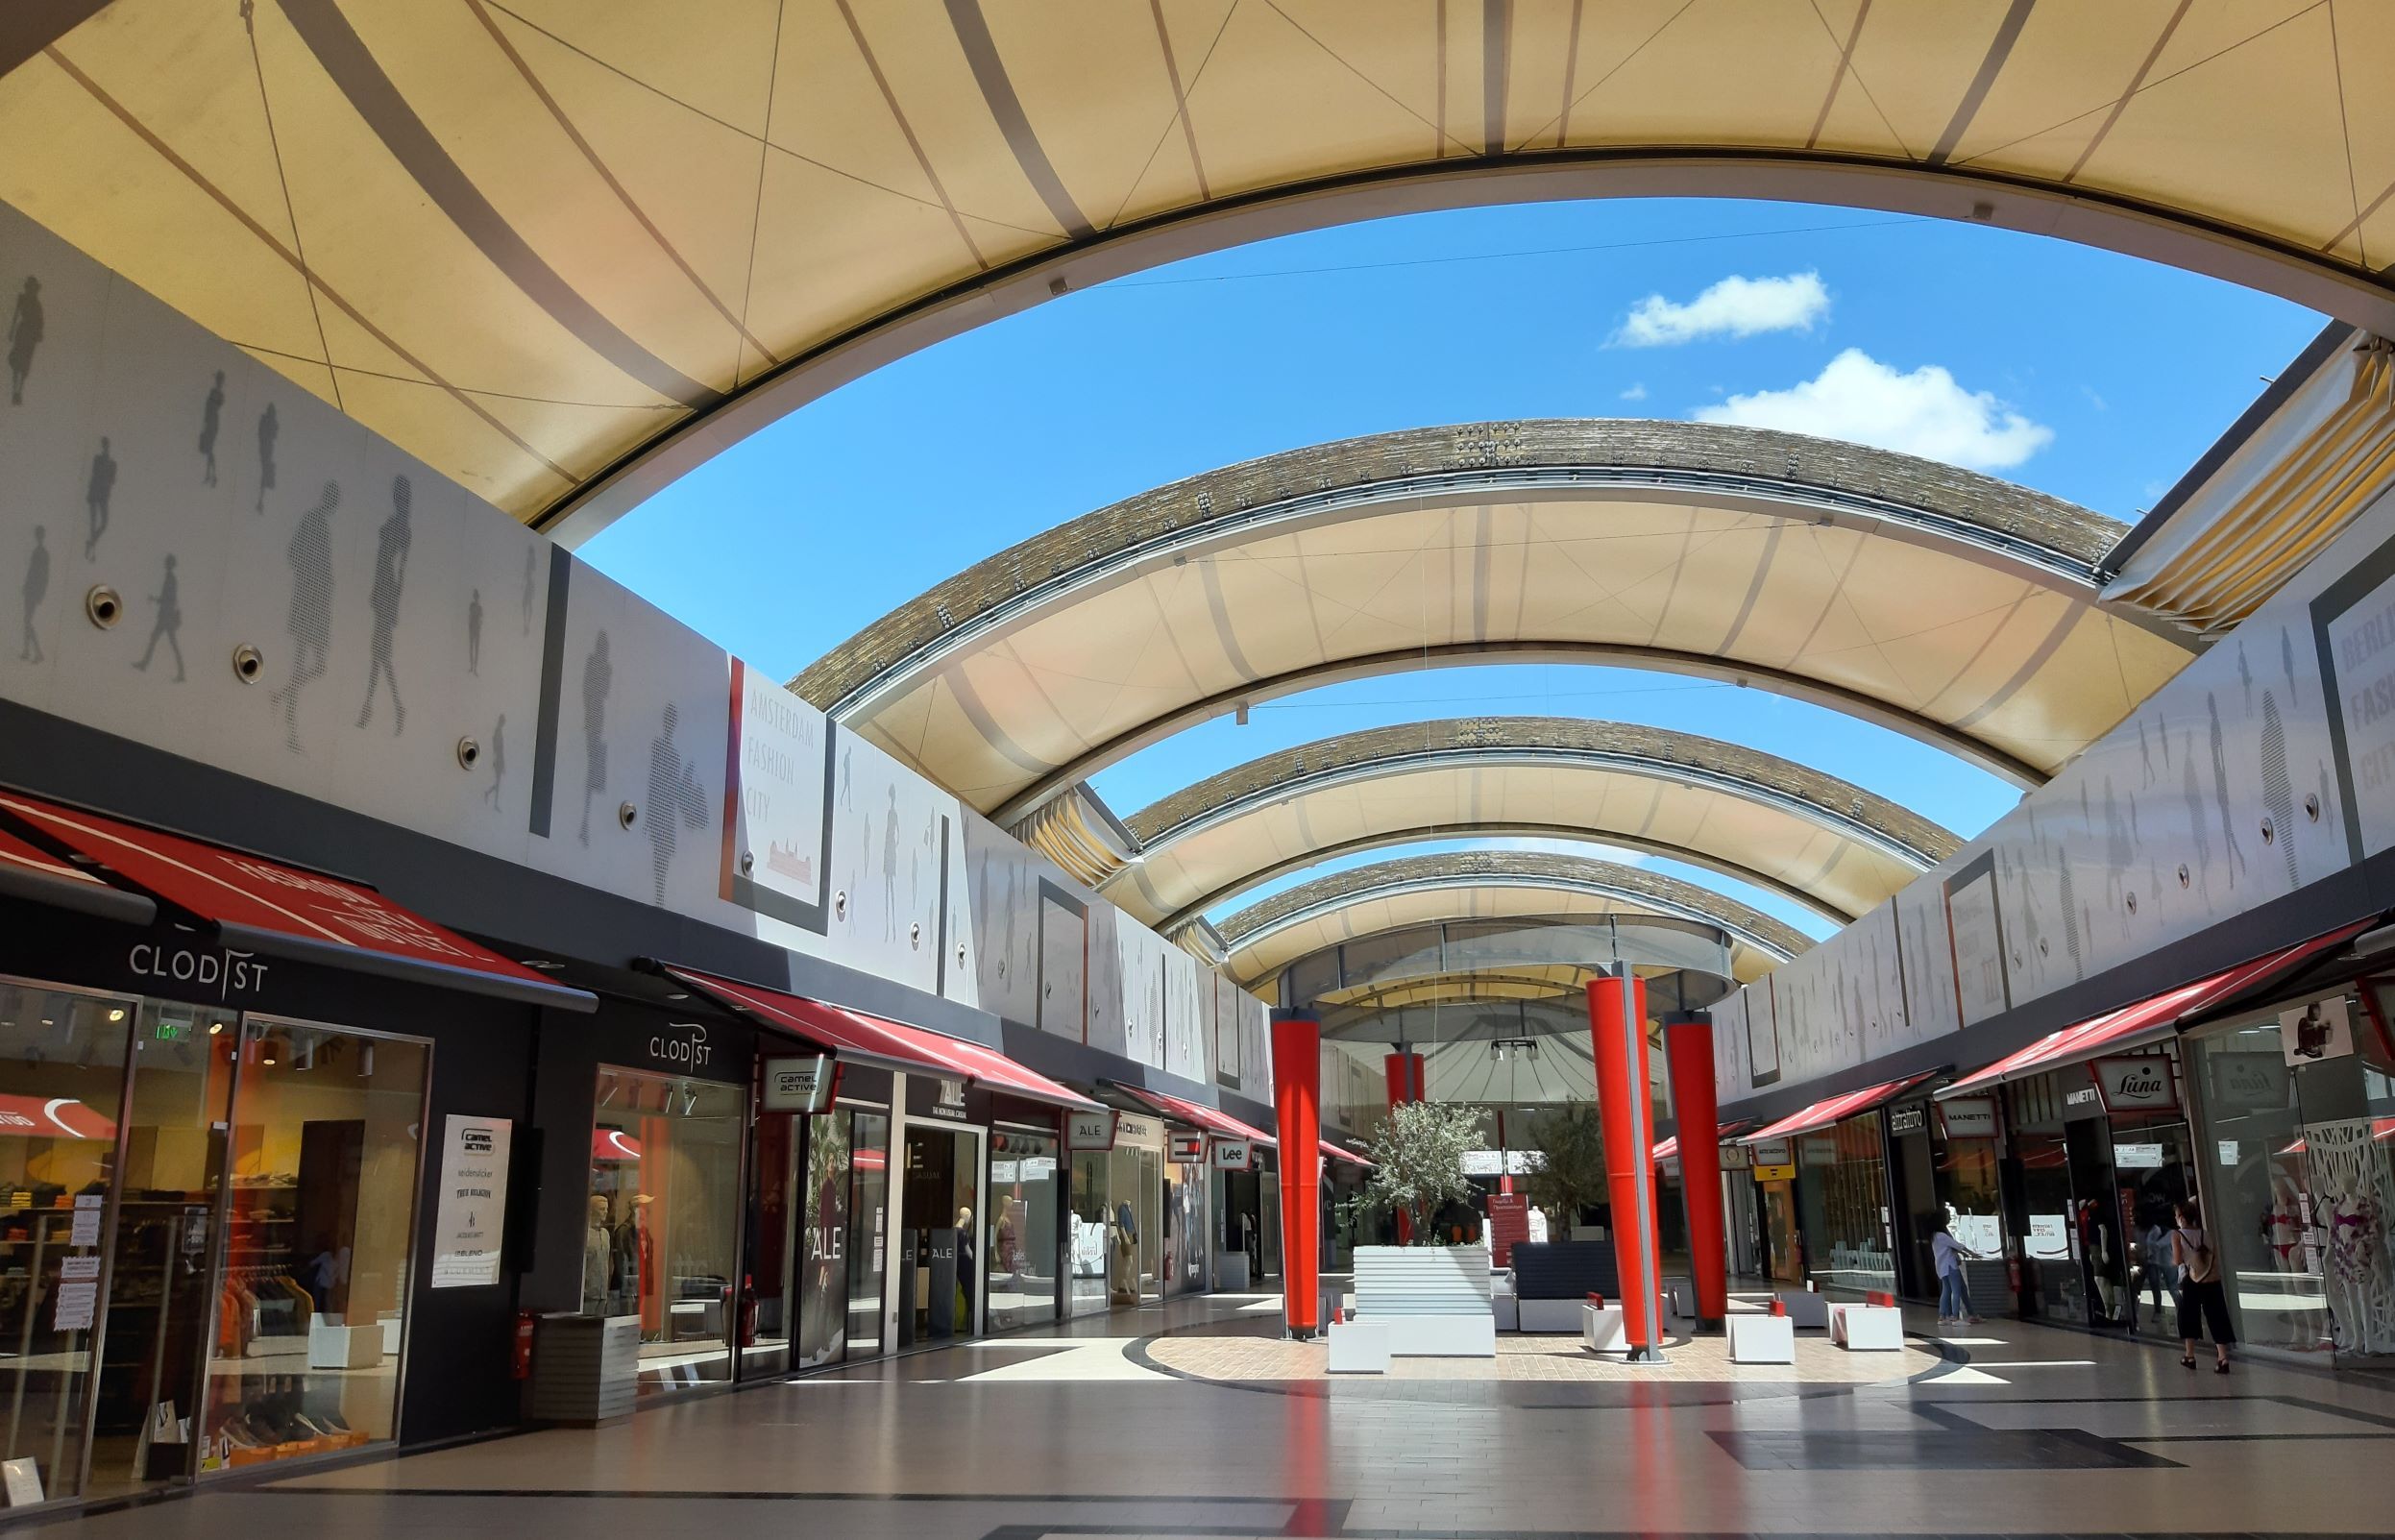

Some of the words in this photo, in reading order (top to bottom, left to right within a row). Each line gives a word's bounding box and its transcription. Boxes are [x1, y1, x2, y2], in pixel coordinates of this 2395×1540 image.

[2341, 602, 2395, 673] BERLI
[750, 690, 814, 749] AMSTERDAM
[747, 737, 794, 785] FASHION
[745, 787, 770, 823] CITY
[216, 855, 382, 908] FASHION
[129, 943, 269, 1002] CLODIST
[2066, 1088, 2096, 1105] MANETTI
[464, 1143, 492, 1152] active
[465, 1134, 492, 1142] camel
[1222, 1148, 1242, 1160] Lee
